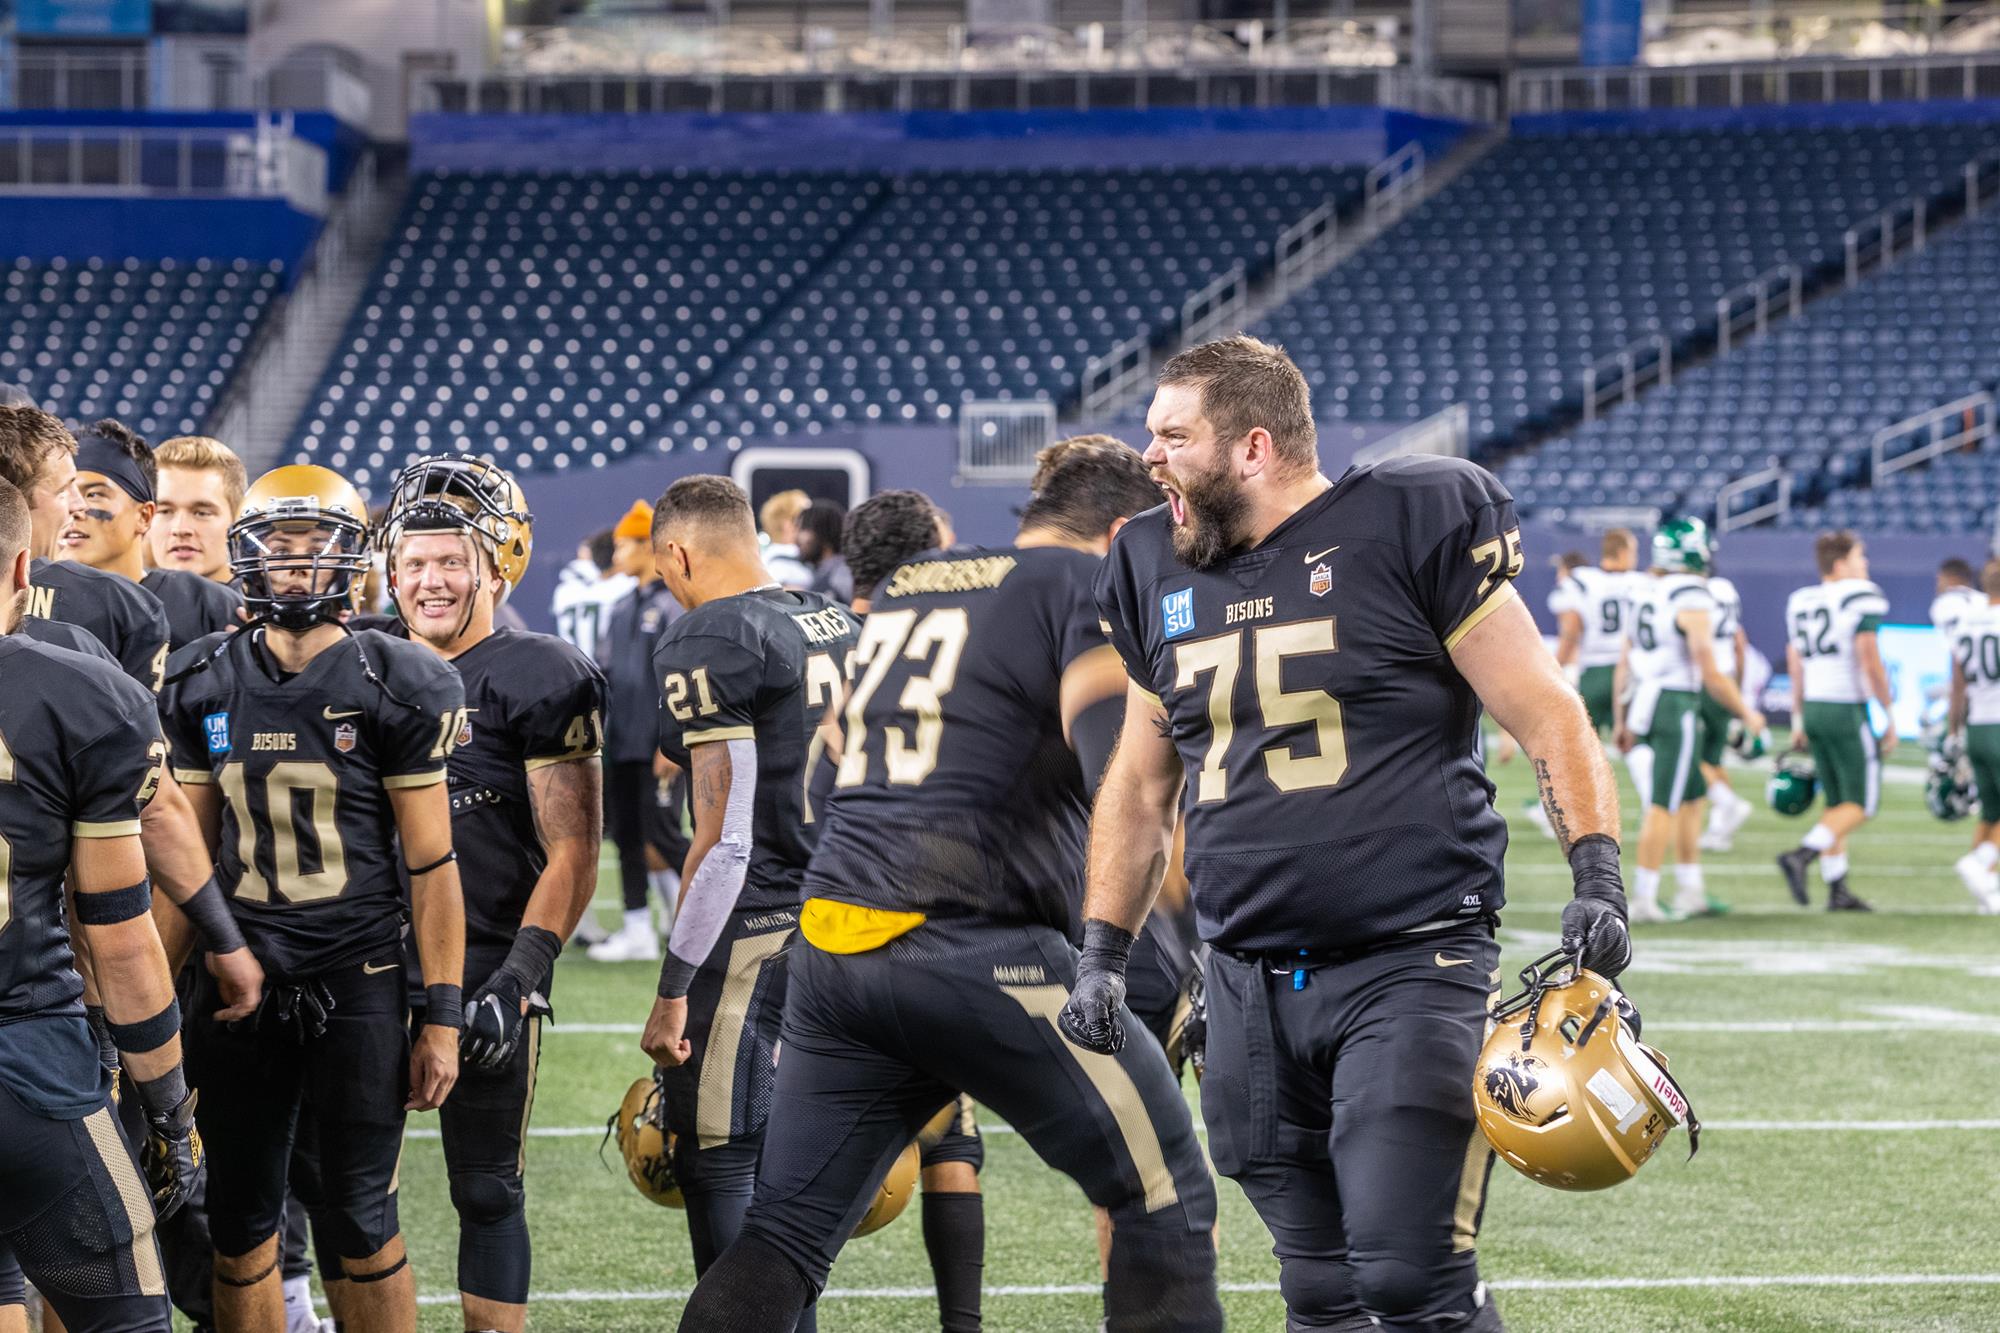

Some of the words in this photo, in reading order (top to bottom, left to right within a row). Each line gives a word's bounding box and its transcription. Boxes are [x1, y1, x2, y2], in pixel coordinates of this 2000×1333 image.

[1470, 529, 1525, 596] 75
[1165, 592, 1190, 615] UM
[1312, 580, 1330, 592] WEST
[1167, 609, 1191, 632] SU
[1225, 596, 1274, 625] BISONS
[1796, 607, 1839, 658] 52
[1958, 634, 2000, 683] 20
[664, 666, 720, 722] 21
[834, 606, 969, 788] 73
[1173, 615, 1351, 805] 75
[207, 715, 227, 733] UM
[210, 732, 229, 749] SU
[251, 732, 297, 751] BISONS
[429, 705, 468, 760] 10
[564, 708, 605, 754] 41
[217, 760, 351, 905] 10
[1462, 894, 1482, 906] 4XL
[744, 912, 797, 931] MANITOBA
